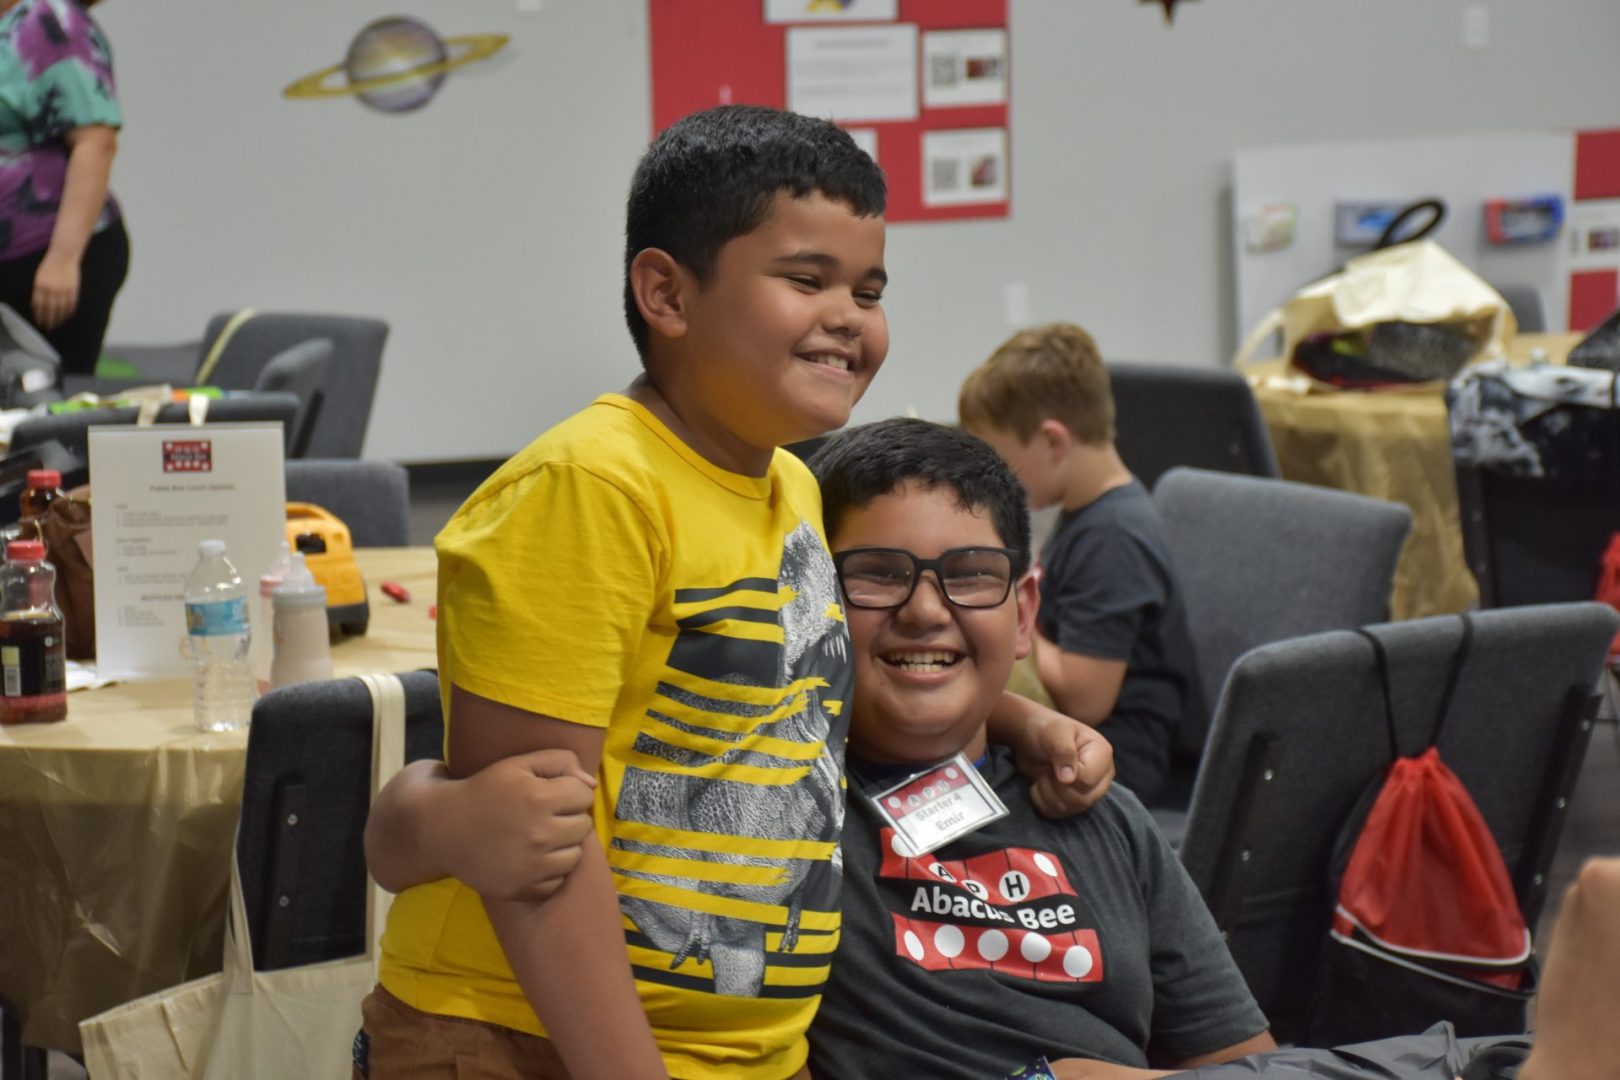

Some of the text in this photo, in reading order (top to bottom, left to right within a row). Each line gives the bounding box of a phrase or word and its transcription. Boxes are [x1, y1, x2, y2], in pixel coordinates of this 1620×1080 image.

[915, 798, 953, 821] Starter
[935, 811, 965, 831] Emir
[911, 886, 1076, 930] Abacus Bee
